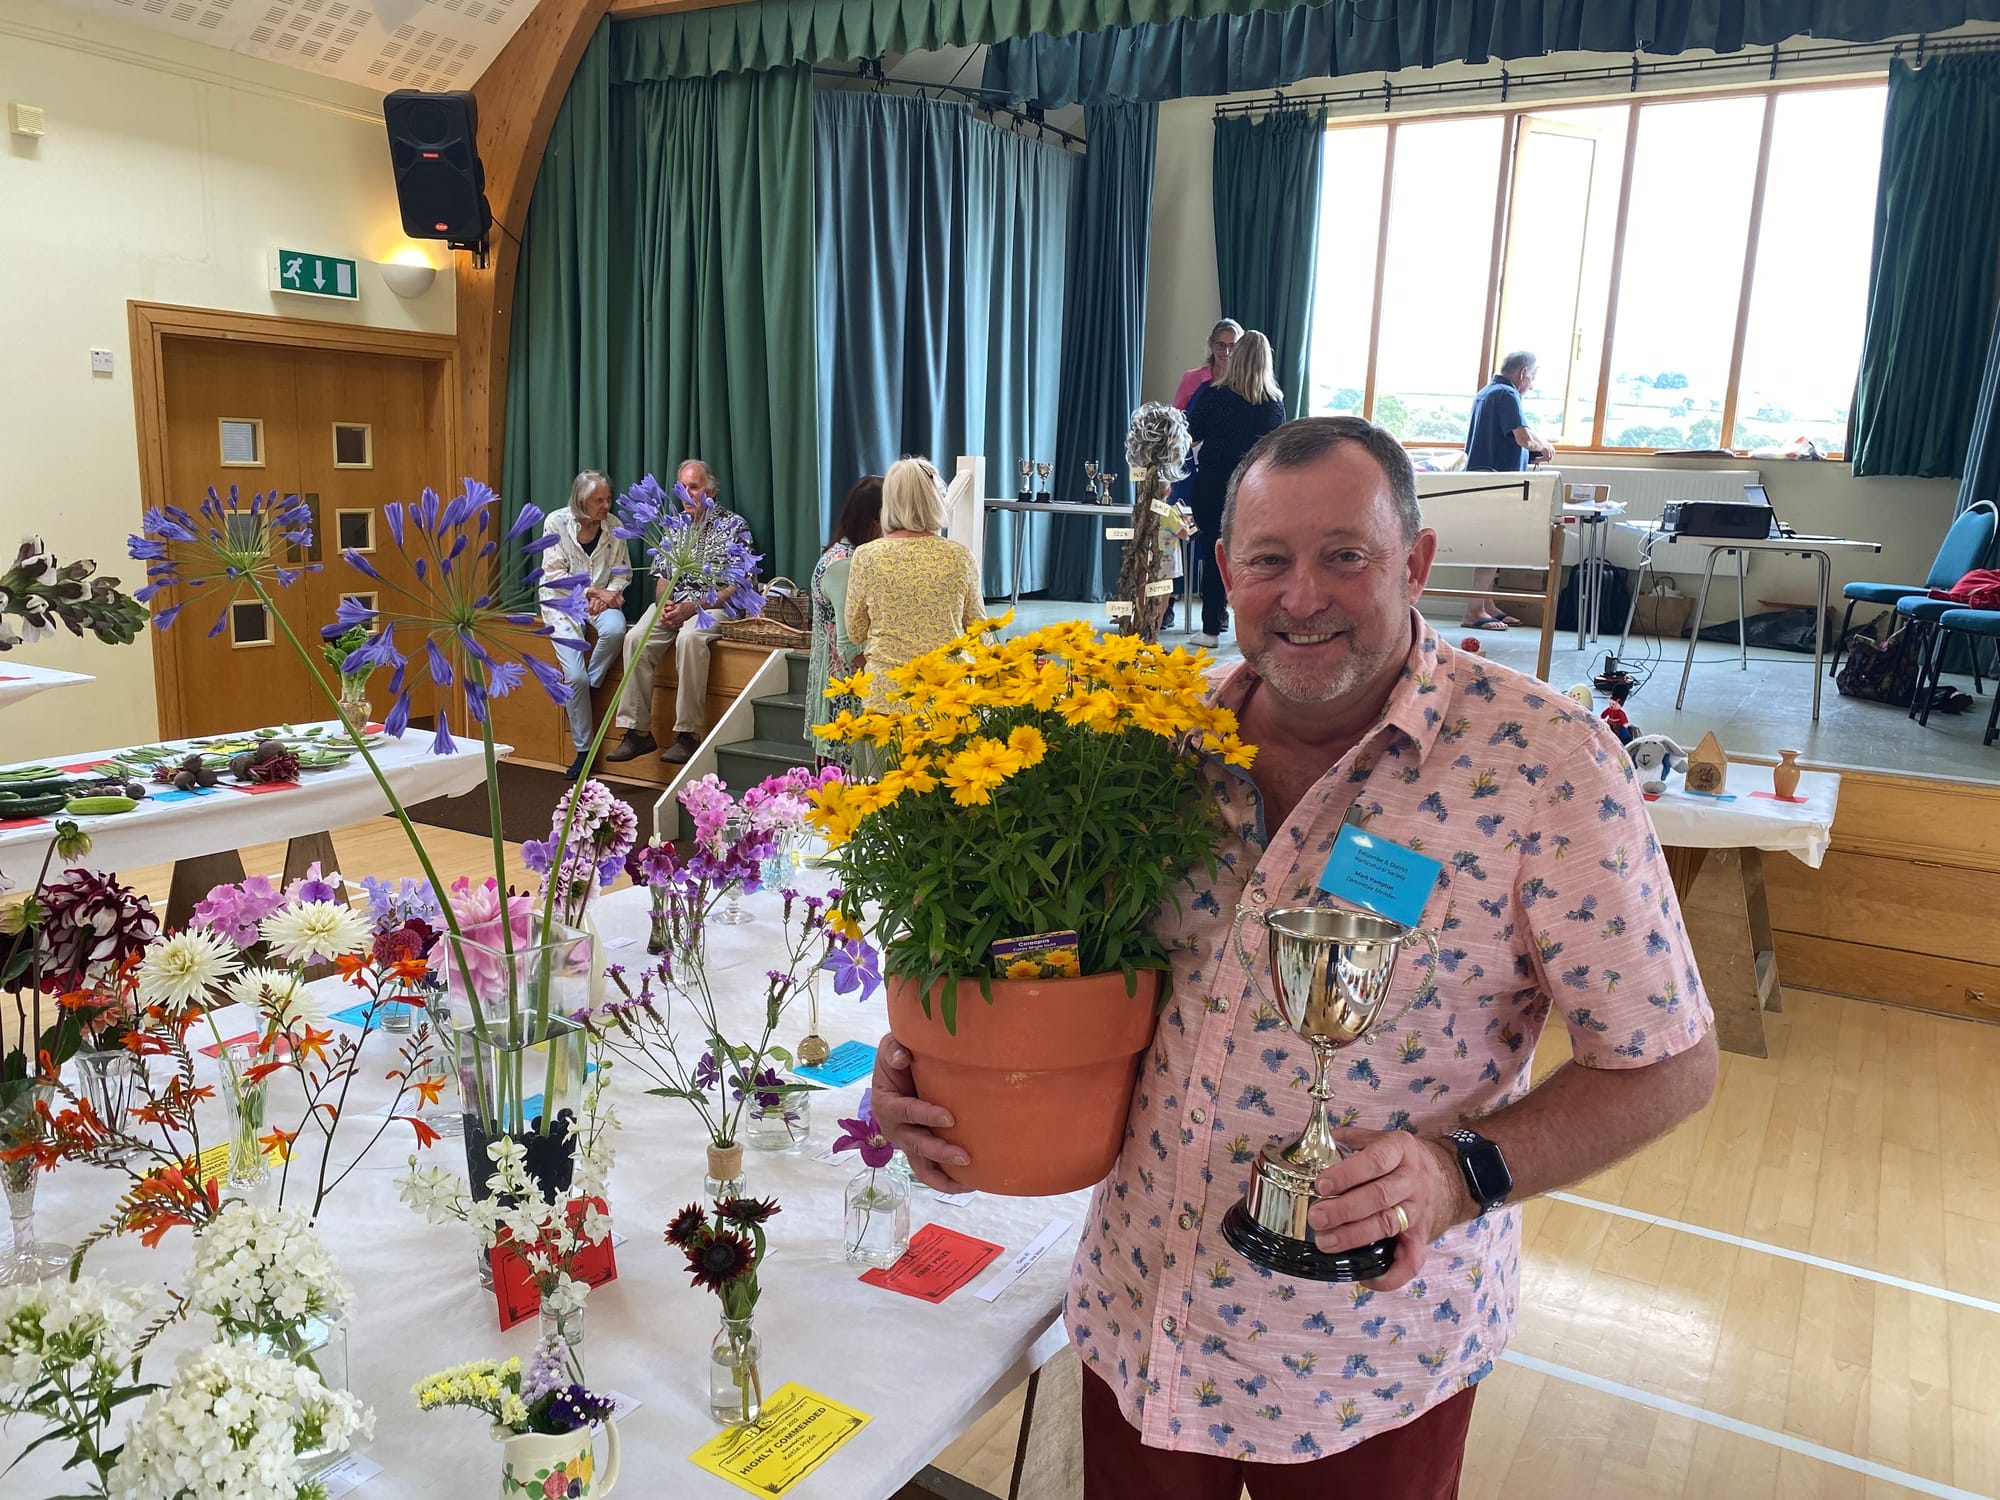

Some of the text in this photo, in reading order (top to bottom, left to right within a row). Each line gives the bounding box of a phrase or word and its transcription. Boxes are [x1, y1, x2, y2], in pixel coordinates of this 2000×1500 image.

[1354, 856, 1406, 881] Horticultural Society
[1390, 862, 1408, 873] District
[1346, 876, 1397, 900] Committee Member
[1355, 870, 1394, 891] Mark Hampton
[1018, 938, 1050, 947] Coreopsis
[914, 1263, 933, 1278] FIRST
[931, 1250, 951, 1264] PRIZE
[740, 1448, 774, 1474] HIGHLY
[774, 1407, 826, 1448] COMMENDED
[752, 1439, 773, 1455] ANNUAL
[771, 1426, 787, 1439] SHOW
